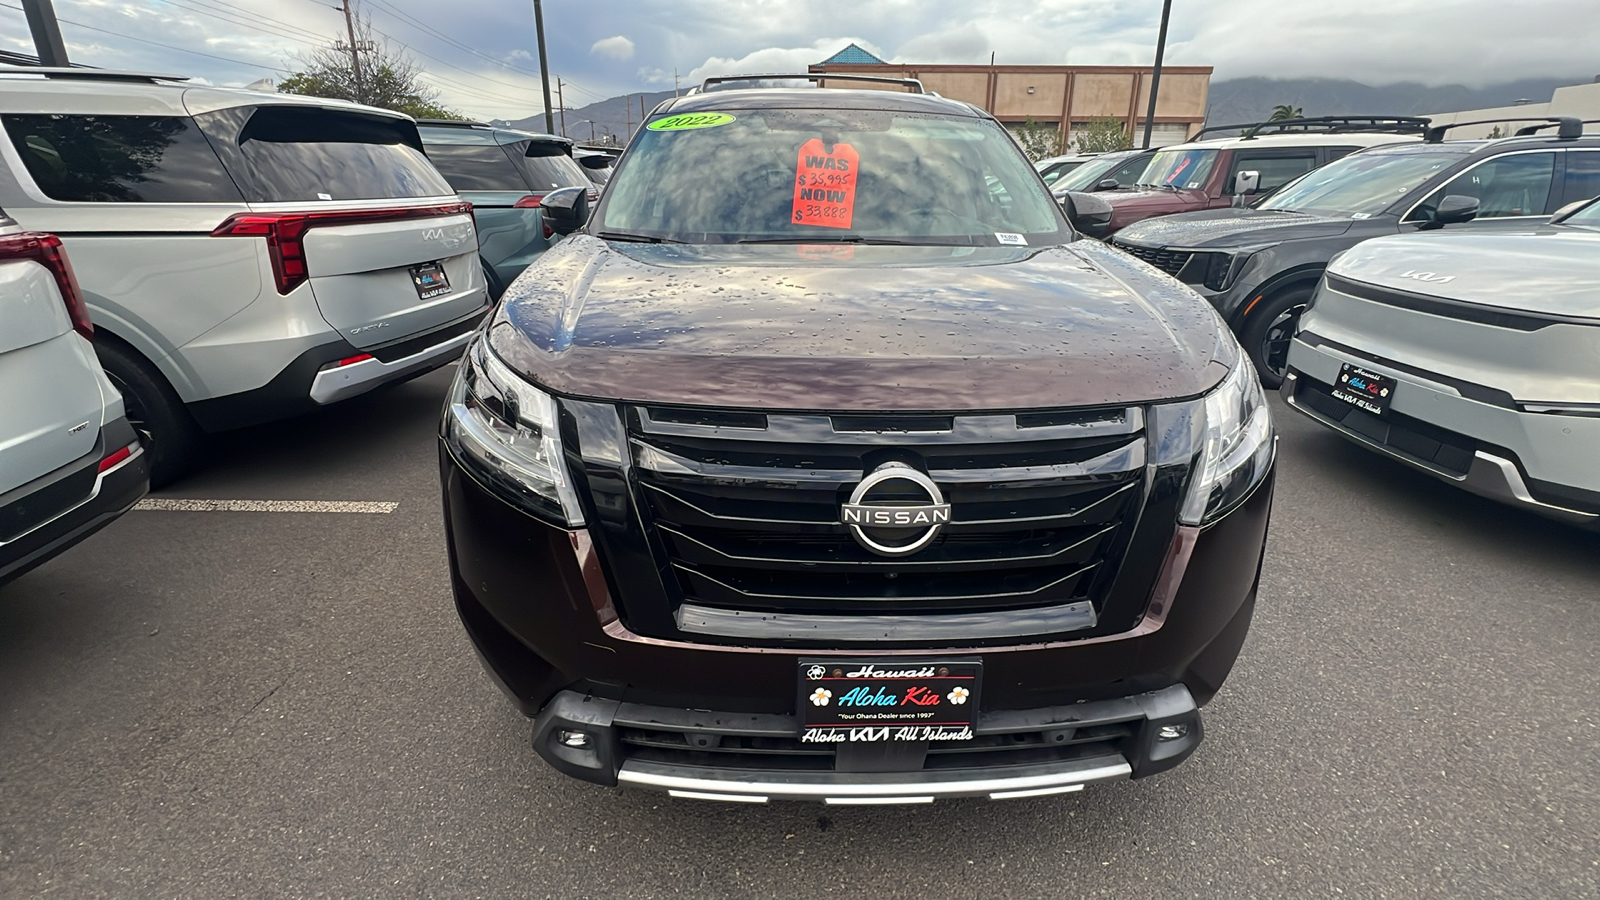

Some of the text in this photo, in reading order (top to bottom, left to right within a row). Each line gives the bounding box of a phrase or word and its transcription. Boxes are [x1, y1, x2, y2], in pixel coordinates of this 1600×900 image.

[659, 115, 722, 128] 2022
[805, 155, 849, 171] WAS
[798, 172, 850, 187] $ 35,995
[800, 188, 846, 204] NOW
[795, 204, 847, 221] $ 33,888
[1347, 377, 1367, 389] Aloha
[1366, 382, 1379, 395] Kia
[844, 508, 948, 524] NISSAN
[846, 665, 935, 678] Hawaii
[838, 686, 941, 706] Aloha Kia
[802, 728, 846, 743] Aloha
[894, 726, 922, 741] All
[923, 725, 973, 741] Islands
